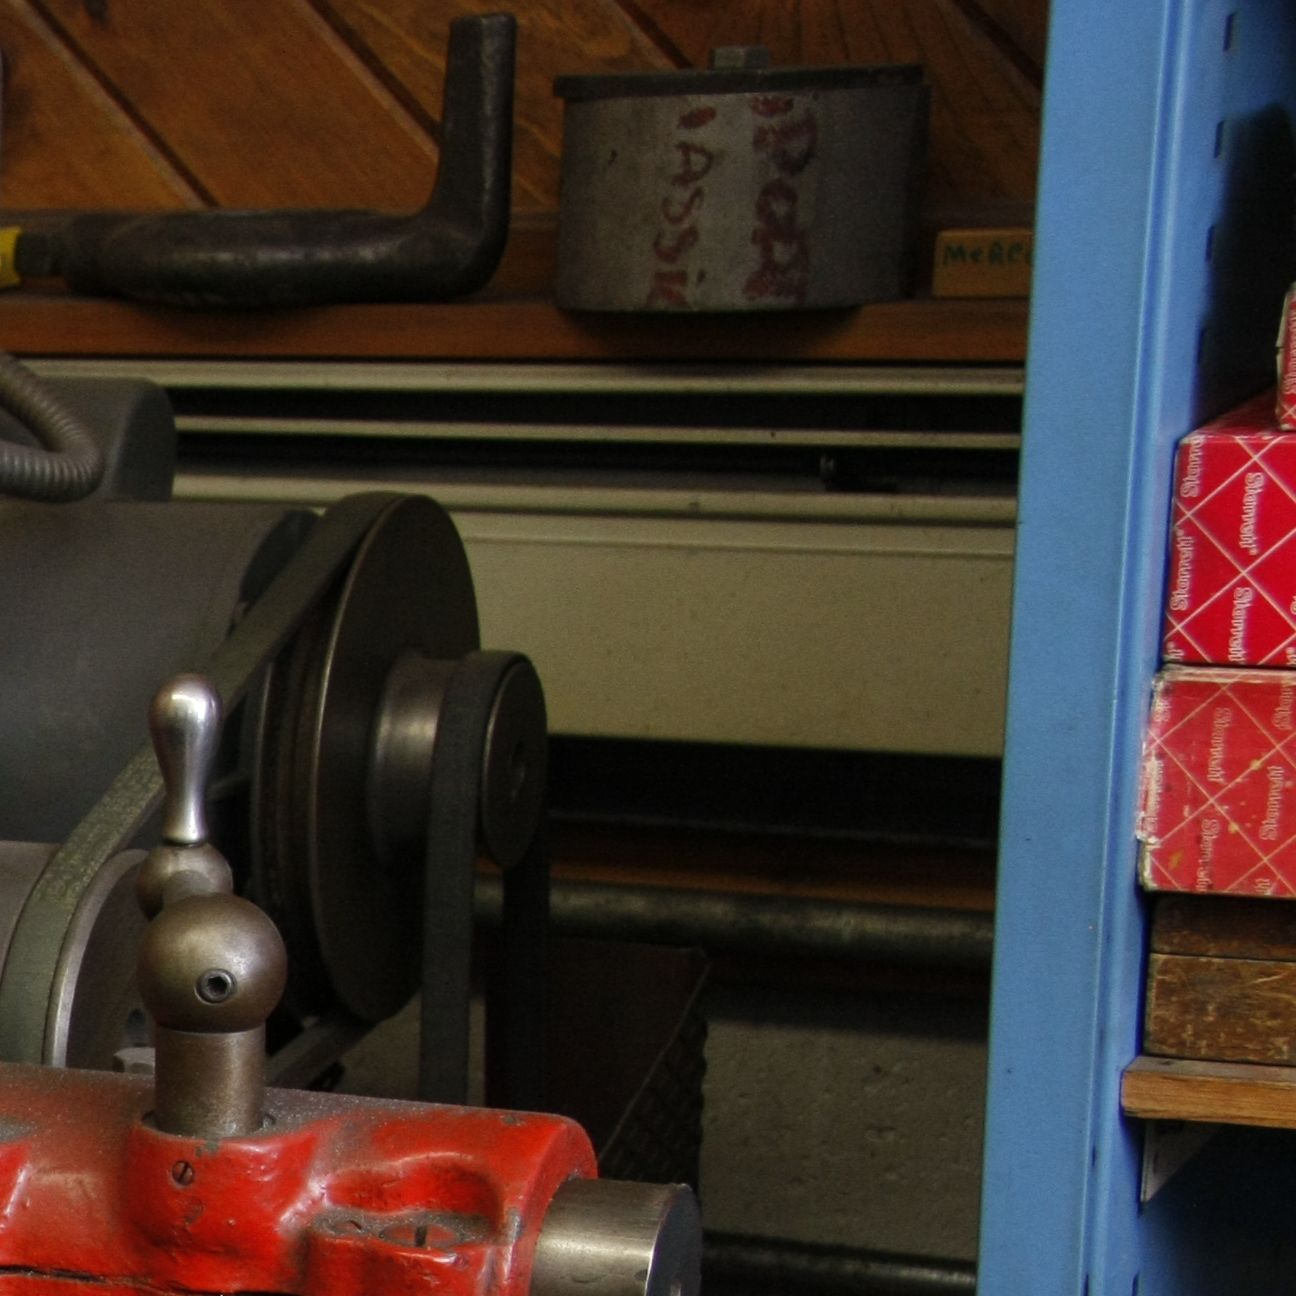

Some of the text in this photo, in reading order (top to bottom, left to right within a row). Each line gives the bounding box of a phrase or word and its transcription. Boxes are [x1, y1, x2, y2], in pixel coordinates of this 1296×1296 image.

[1239, 472, 1264, 550] Starrett
[1169, 536, 1194, 611] Starrett
[1228, 587, 1253, 663] Starrett
[1207, 708, 1233, 784] Starrett
[1259, 766, 1284, 840] Starrett
